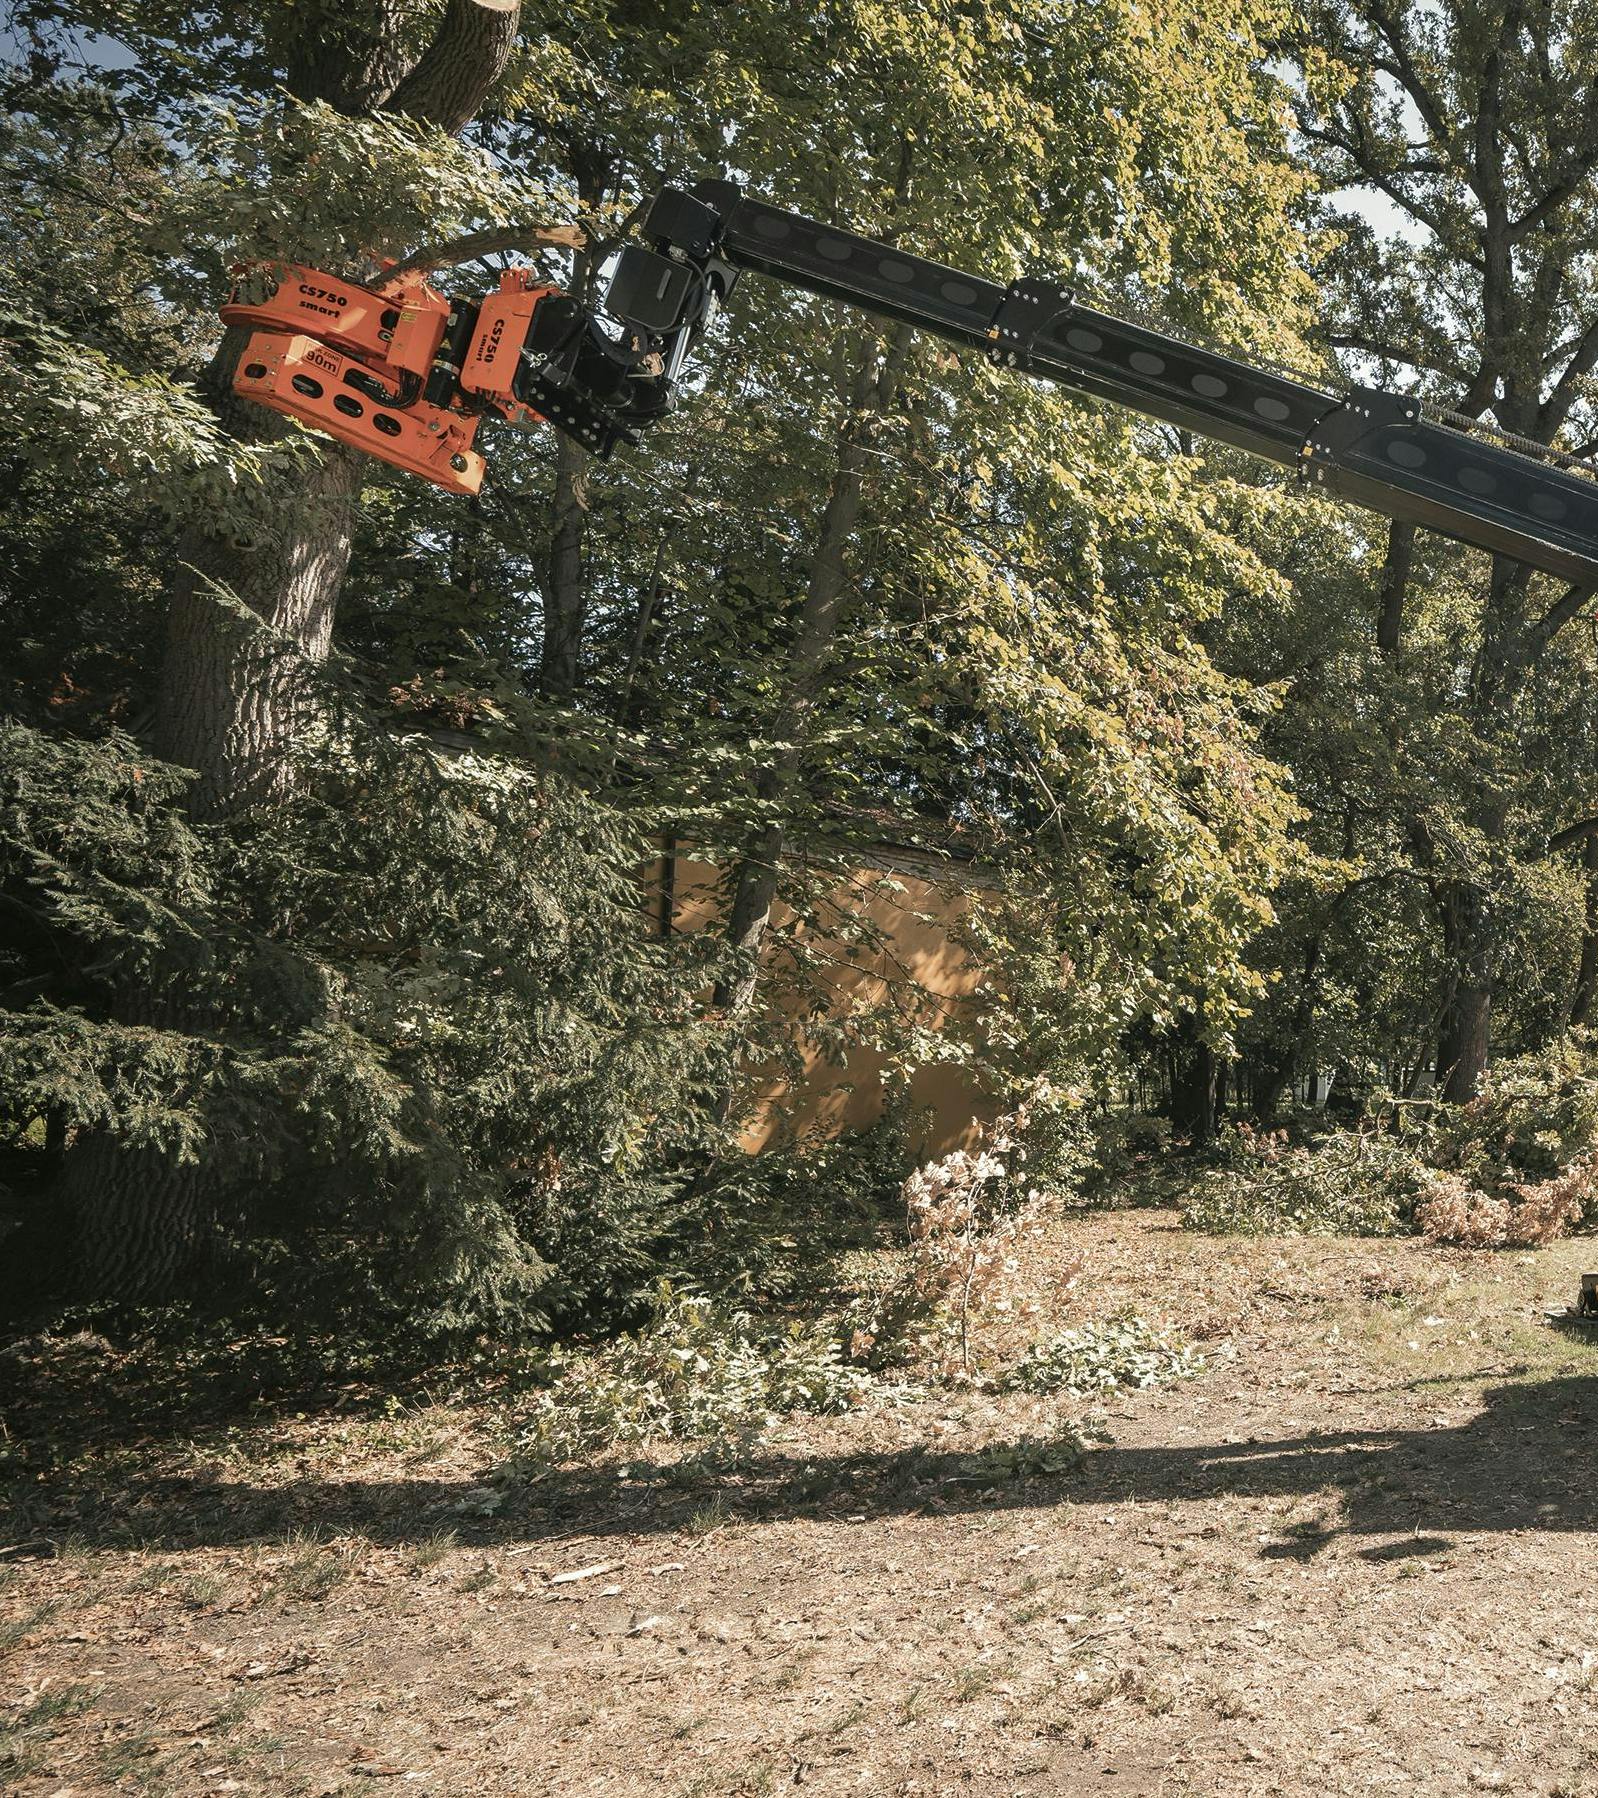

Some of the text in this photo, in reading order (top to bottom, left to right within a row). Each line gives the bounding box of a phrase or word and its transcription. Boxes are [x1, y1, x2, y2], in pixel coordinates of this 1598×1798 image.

[299, 284, 348, 307] CS750
[299, 300, 341, 318] smart
[484, 319, 505, 363] CS750
[306, 350, 337, 373] 90m
